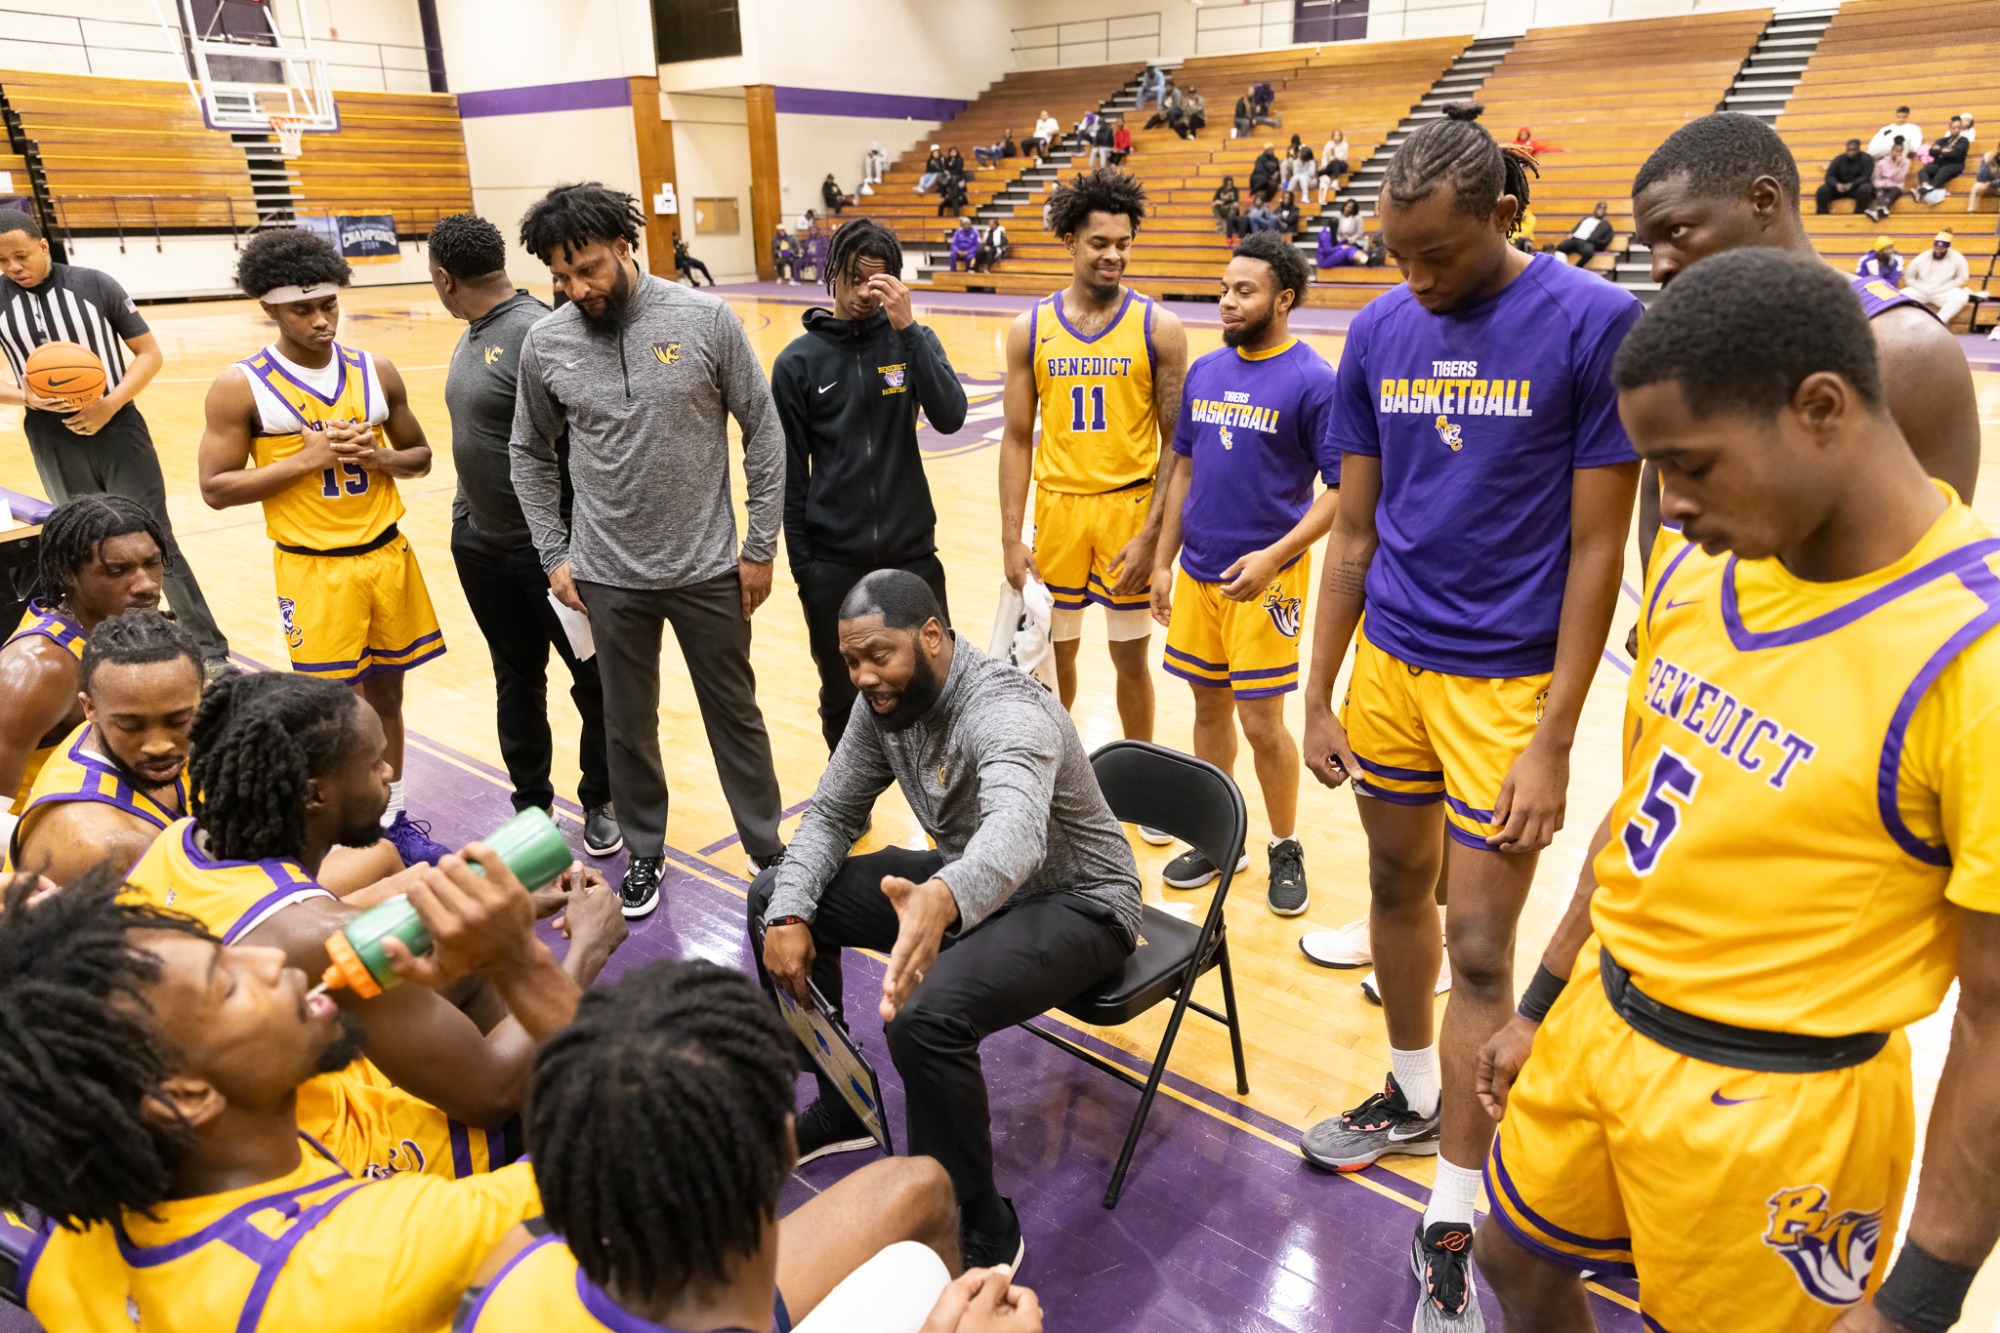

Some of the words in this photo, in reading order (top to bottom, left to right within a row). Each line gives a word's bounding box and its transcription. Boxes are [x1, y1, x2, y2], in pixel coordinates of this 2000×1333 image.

[341, 229, 397, 248] CHAMPIONS
[878, 363, 907, 373] BENEDICT
[1047, 357, 1132, 377] BENEDICT
[1432, 361, 1478, 378] TIGERS
[1070, 384, 1107, 432] 11
[1223, 390, 1250, 404] TIGERS
[1380, 378, 1533, 417] BASKETBALL
[1191, 398, 1280, 434] BASKETBALL
[322, 462, 370, 498] 15
[1621, 743, 1703, 878] 5
